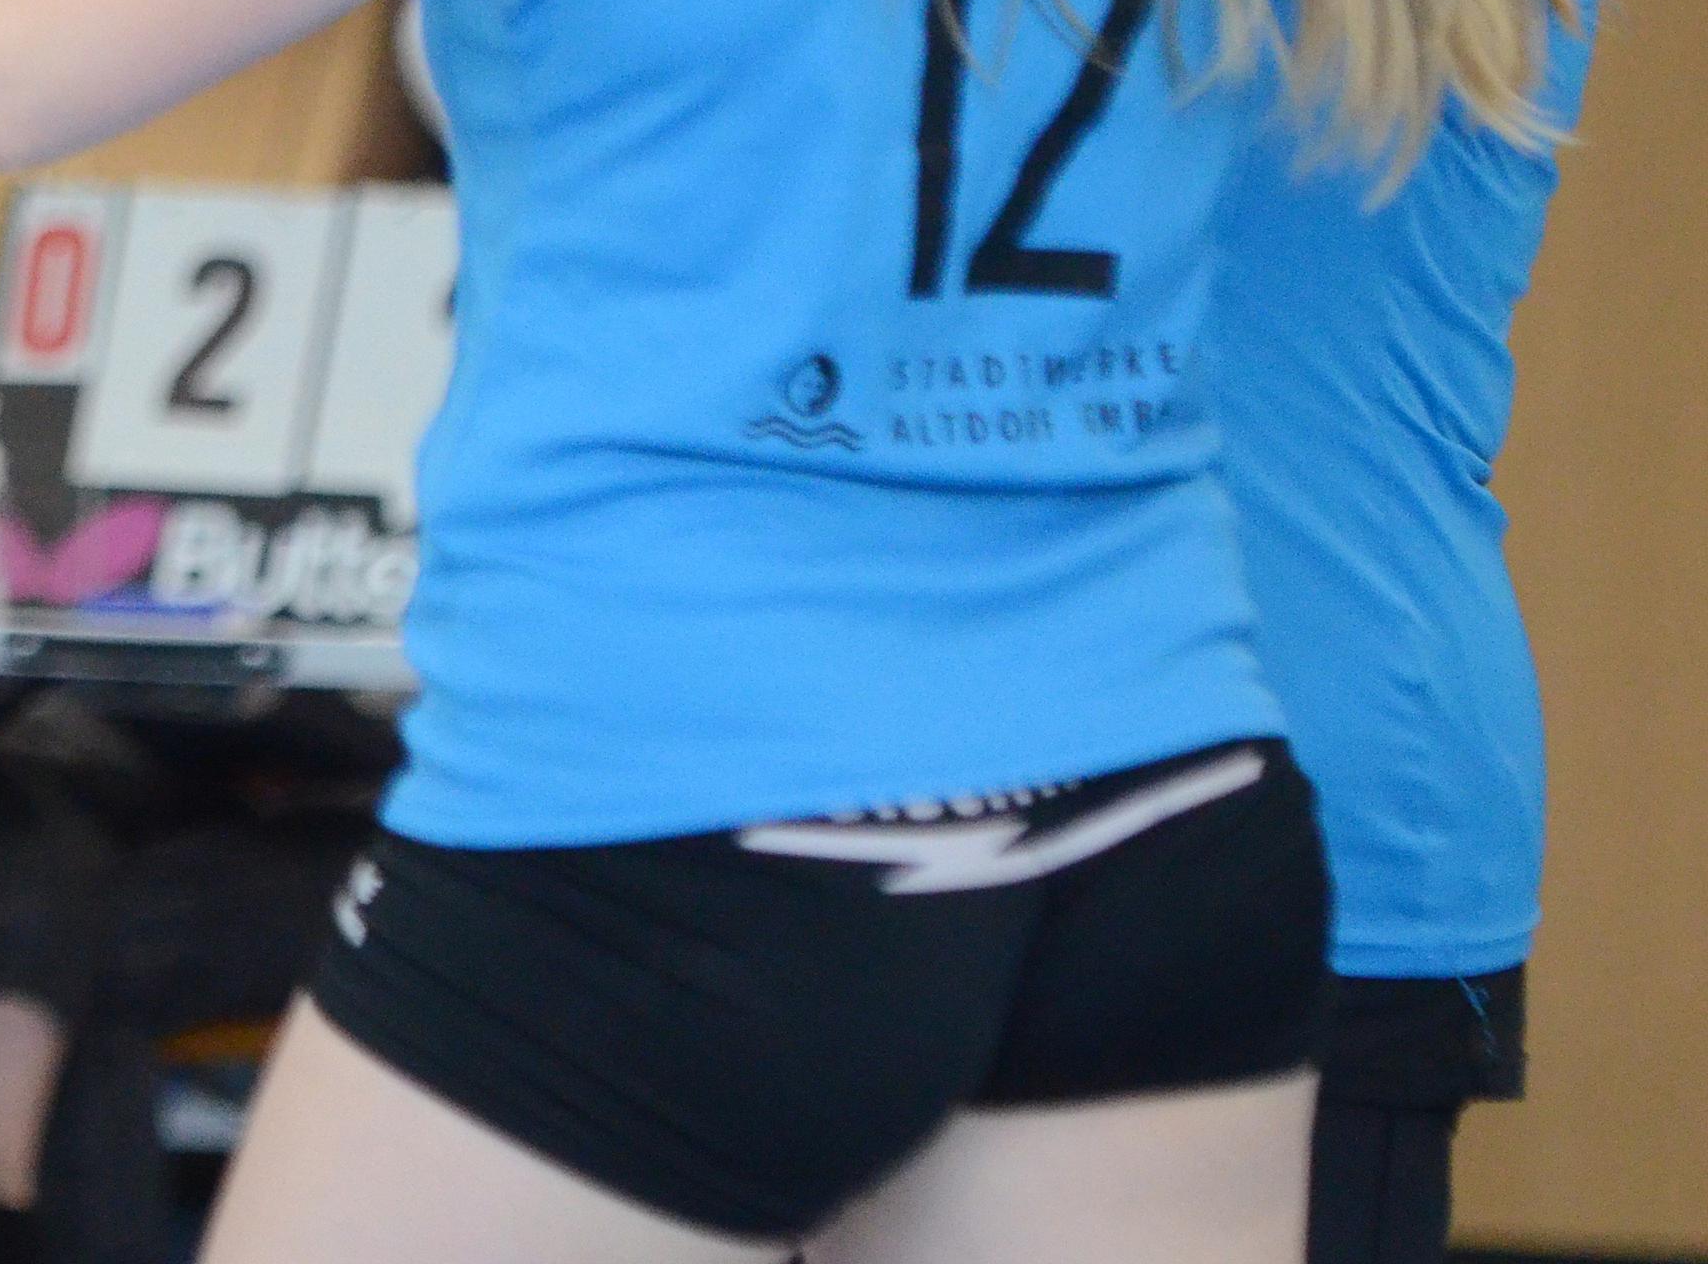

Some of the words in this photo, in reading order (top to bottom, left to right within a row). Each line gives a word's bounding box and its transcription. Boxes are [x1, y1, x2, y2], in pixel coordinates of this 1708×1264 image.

[20, 225, 89, 357] 0
[164, 254, 258, 416] 2
[152, 496, 420, 620] Butte
